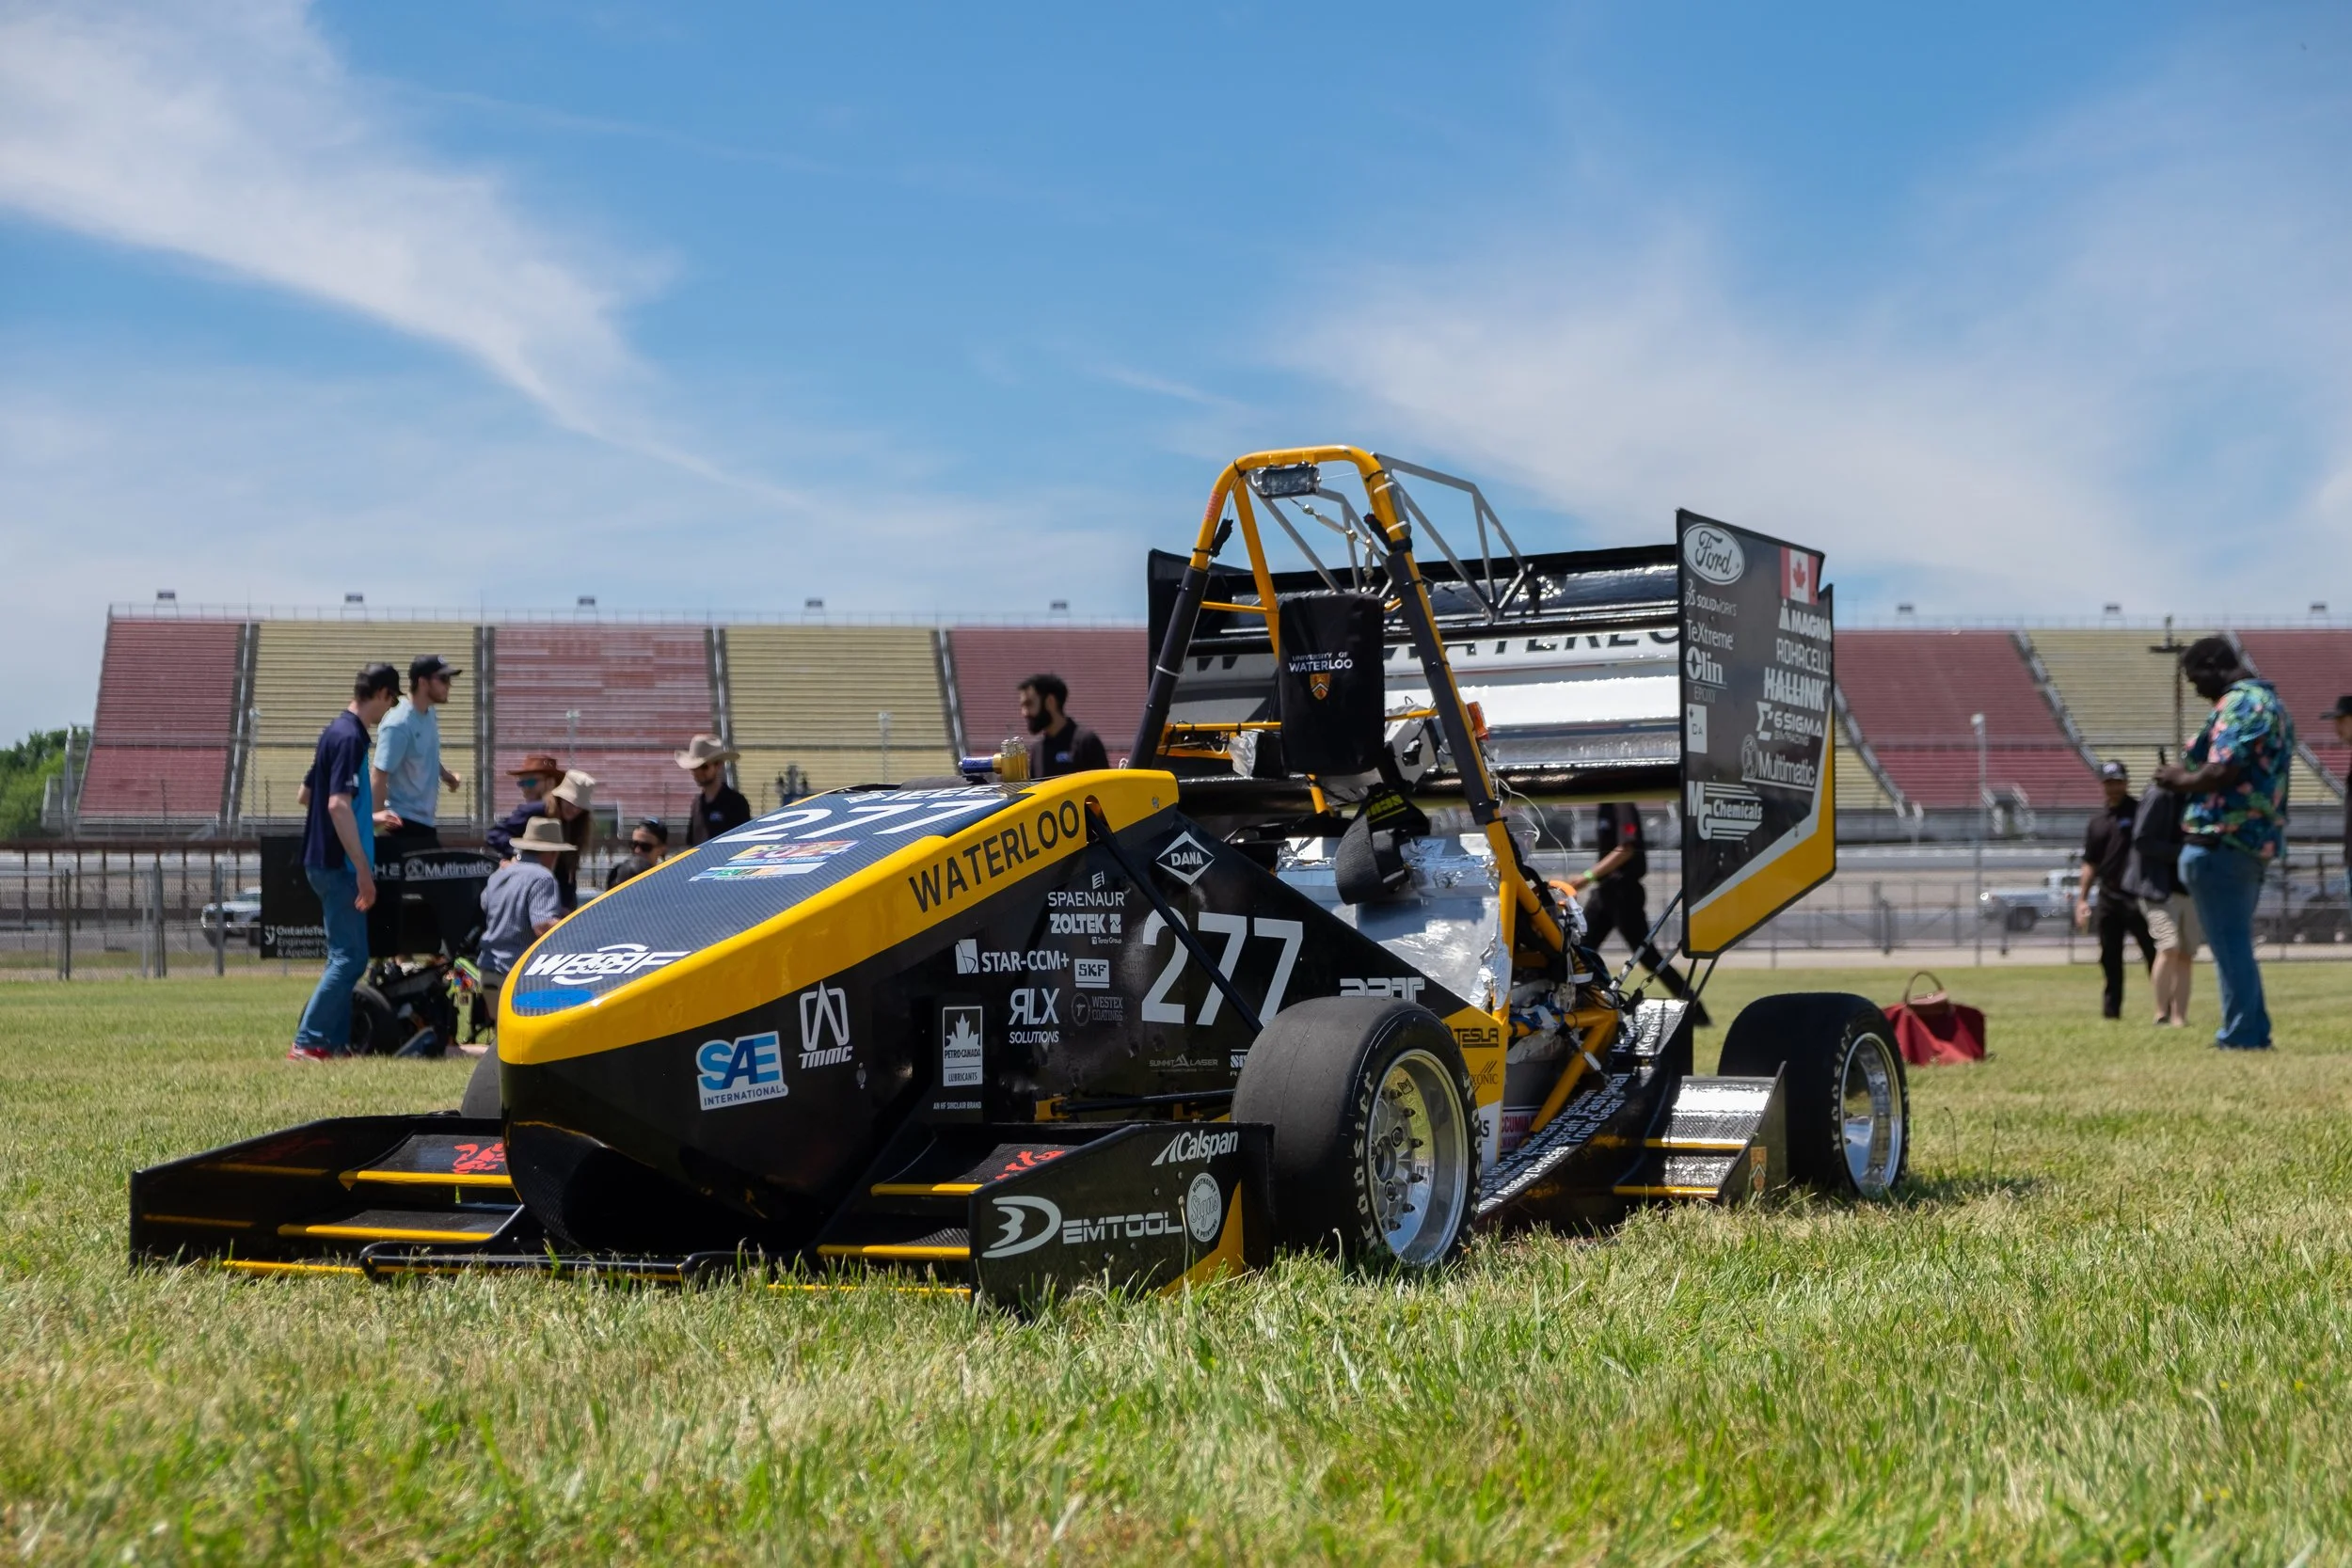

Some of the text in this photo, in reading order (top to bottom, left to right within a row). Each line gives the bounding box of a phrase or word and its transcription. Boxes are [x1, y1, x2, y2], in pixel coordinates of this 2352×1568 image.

[1694, 530, 1733, 576] Ford
[1685, 619, 1735, 650] TeXtreme
[1790, 610, 1832, 642] MAGNA
[1288, 658, 1354, 673] WATERLOO
[1292, 652, 1333, 661] UNIVERSITY
[1686, 646, 1724, 684] Olin
[1776, 637, 1831, 675] ROHACELL
[1693, 686, 1717, 704] EPOXY
[1764, 667, 1826, 712] HALLINK
[1758, 751, 1816, 786] Multimatic
[711, 798, 1005, 844] 277
[1712, 799, 1763, 821] Chemicals
[908, 800, 1080, 913] WATERLOO
[1170, 850, 1204, 866] DANA
[424, 861, 493, 878] Multimatic
[1047, 892, 1125, 907] SPAENAUR
[1049, 913, 1106, 934] ZOLTEK
[981, 950, 1070, 973] STAR-CCM+
[1078, 963, 1107, 976] SKF
[1142, 906, 1304, 1027] 277
[1091, 995, 1124, 1008] WESTEX
[1091, 1009, 1124, 1022] COATINGS
[1009, 1030, 1059, 1044] SOLUTIONS
[1454, 1027, 1500, 1043] TESLA
[696, 1032, 783, 1092] SAE
[798, 1045, 854, 1069] TMMC
[1188, 1058, 1218, 1067] LASER
[947, 1070, 977, 1083] LUBRICANTS
[703, 1085, 781, 1107] INTERNATIONAL
[967, 1101, 982, 1109] BRAND
[1507, 1119, 1558, 1161] Cylindrical
[1552, 1089, 1597, 1125] Precision
[1175, 1131, 1239, 1164] Calspan
[1496, 1167, 1539, 1196] Analog
[1527, 1145, 1569, 1178] Devices
[1563, 1122, 1601, 1143] True
[1590, 1099, 1626, 1121] Gear
[1533, 1118, 1582, 1156] Tirecraft
[1190, 1193, 1220, 1228] Signs
